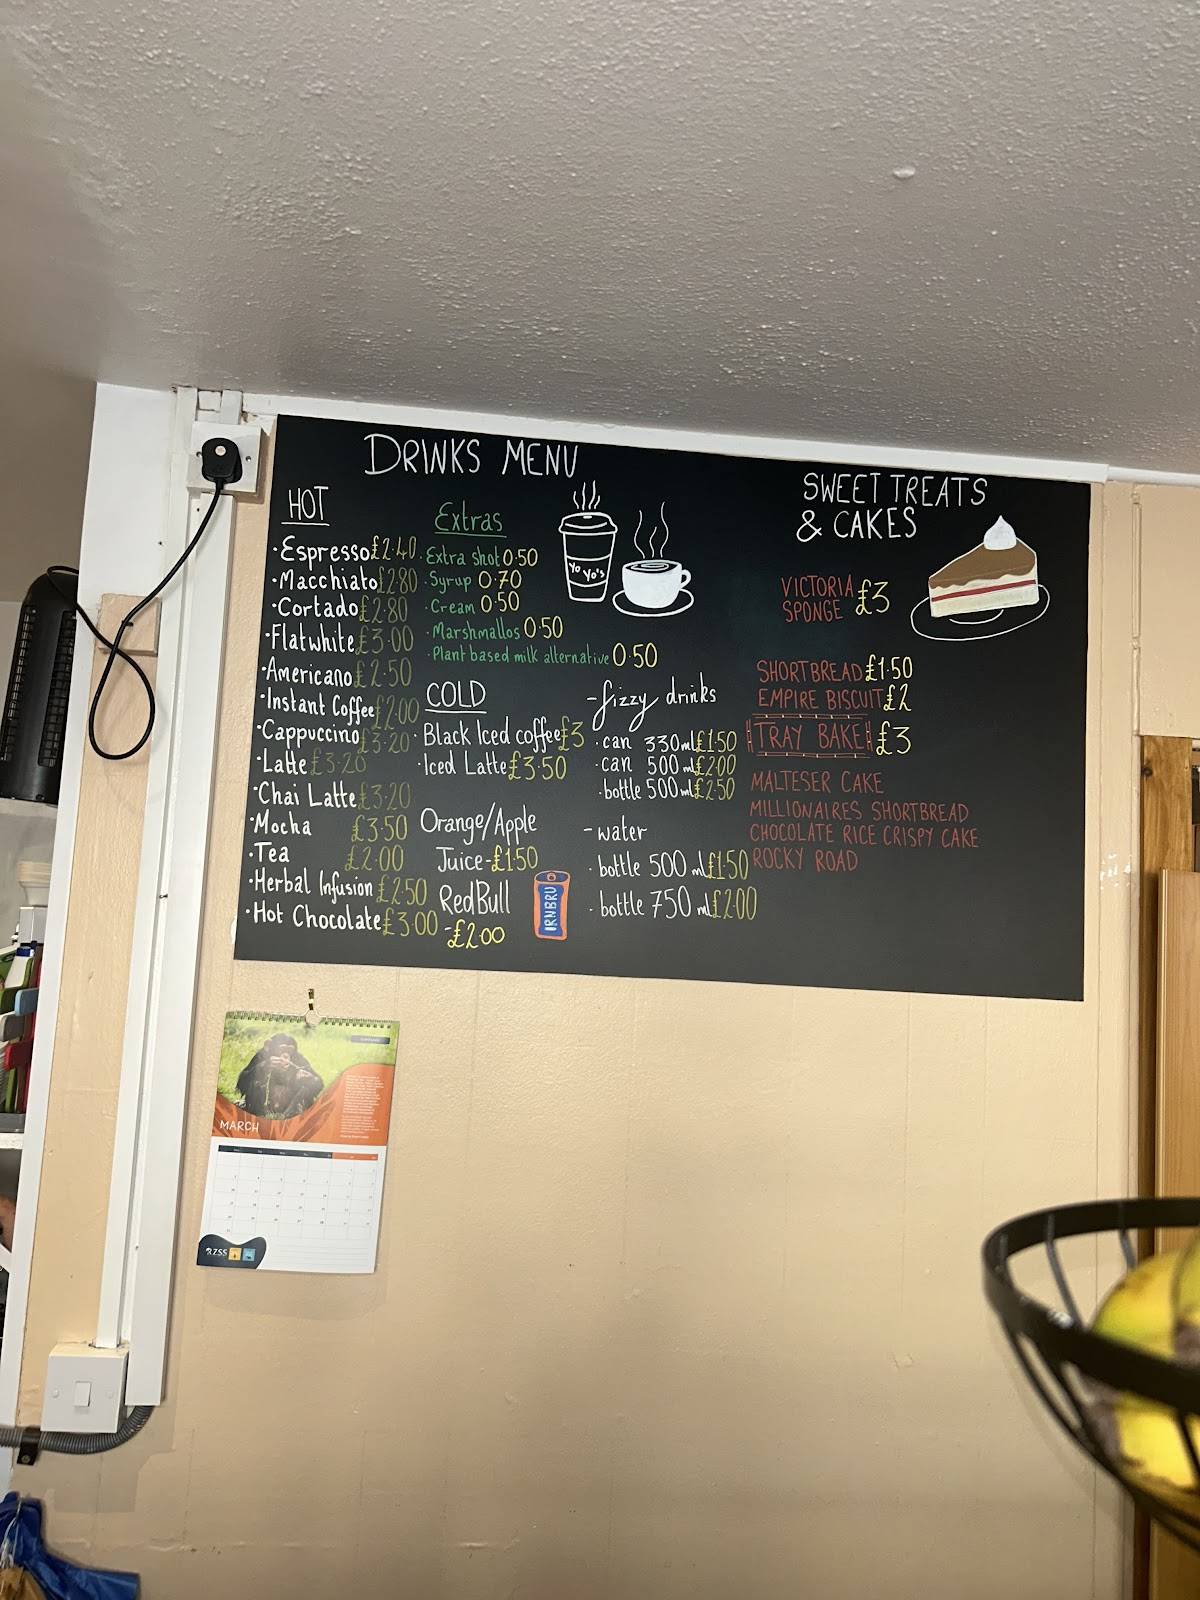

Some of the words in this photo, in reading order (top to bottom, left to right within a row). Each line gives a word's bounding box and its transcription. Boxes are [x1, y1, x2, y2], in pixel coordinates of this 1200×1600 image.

[364, 433, 480, 475] DRINKS
[502, 440, 578, 478] MENU
[288, 485, 329, 520] HOT
[803, 472, 880, 503] SWEET
[890, 474, 988, 507] TREATS
[435, 500, 503, 531] Extras
[796, 509, 822, 542] &
[833, 506, 917, 539] CAKES
[280, 535, 371, 571] Espresso
[426, 546, 466, 566] Extra
[471, 546, 501, 566] shot
[279, 565, 378, 590] Macchiato
[430, 572, 472, 595] Syrup
[277, 594, 359, 618] Cortado
[431, 598, 475, 615] Cream
[780, 574, 854, 598] VICTORIA
[855, 579, 890, 615] £3
[782, 599, 843, 623] SPONGE
[271, 622, 355, 653] Flatwhite
[432, 617, 520, 641] Marshmallos
[432, 646, 467, 663] Plant
[470, 644, 510, 664] based
[514, 648, 539, 664] milk
[543, 643, 610, 666] alternative
[266, 656, 353, 687] Americano
[757, 660, 863, 683] SHORTBREAD
[426, 680, 486, 708] COLD
[666, 671, 716, 705] drinks
[758, 688, 819, 709] EMPIRE
[827, 688, 884, 711] BISCUIT
[883, 683, 912, 711] £2
[267, 687, 326, 716] Instant
[332, 695, 375, 726] Coffee
[262, 719, 360, 749] Cappuccino
[423, 720, 472, 746] Black
[476, 716, 511, 745] Iced
[515, 716, 561, 753] coffee
[558, 715, 585, 751] £3
[602, 735, 632, 750] can
[753, 721, 802, 750] TRAY
[819, 723, 865, 749] BAKE
[876, 720, 912, 756] £3
[263, 748, 308, 775] Latte
[423, 750, 456, 776] Iced
[465, 750, 507, 775] Latte
[601, 756, 633, 773] can
[258, 781, 300, 805] Chai
[308, 780, 357, 808] Latte
[604, 777, 642, 800] bottle
[751, 770, 831, 794] MALTESER
[841, 771, 885, 794] CAKE
[253, 809, 312, 836] Mocha
[750, 800, 863, 821] MILLIONAIRES
[871, 801, 969, 823] SHORTBREAD
[598, 815, 648, 842] water
[750, 823, 834, 843] CHOCOLATE
[843, 824, 877, 845] RICE
[883, 826, 933, 848] CRISPY
[941, 828, 979, 848] CAKE
[253, 841, 290, 863] Tea
[598, 851, 641, 878] bottle
[753, 847, 803, 870] ROCKY
[816, 849, 858, 872] ROAD
[255, 867, 311, 894] Herbal
[319, 870, 373, 904] Infusion
[253, 900, 283, 924] Hot
[292, 904, 382, 930] Chocolate
[600, 890, 645, 917] bottle
[219, 1120, 259, 1133] MARCH
